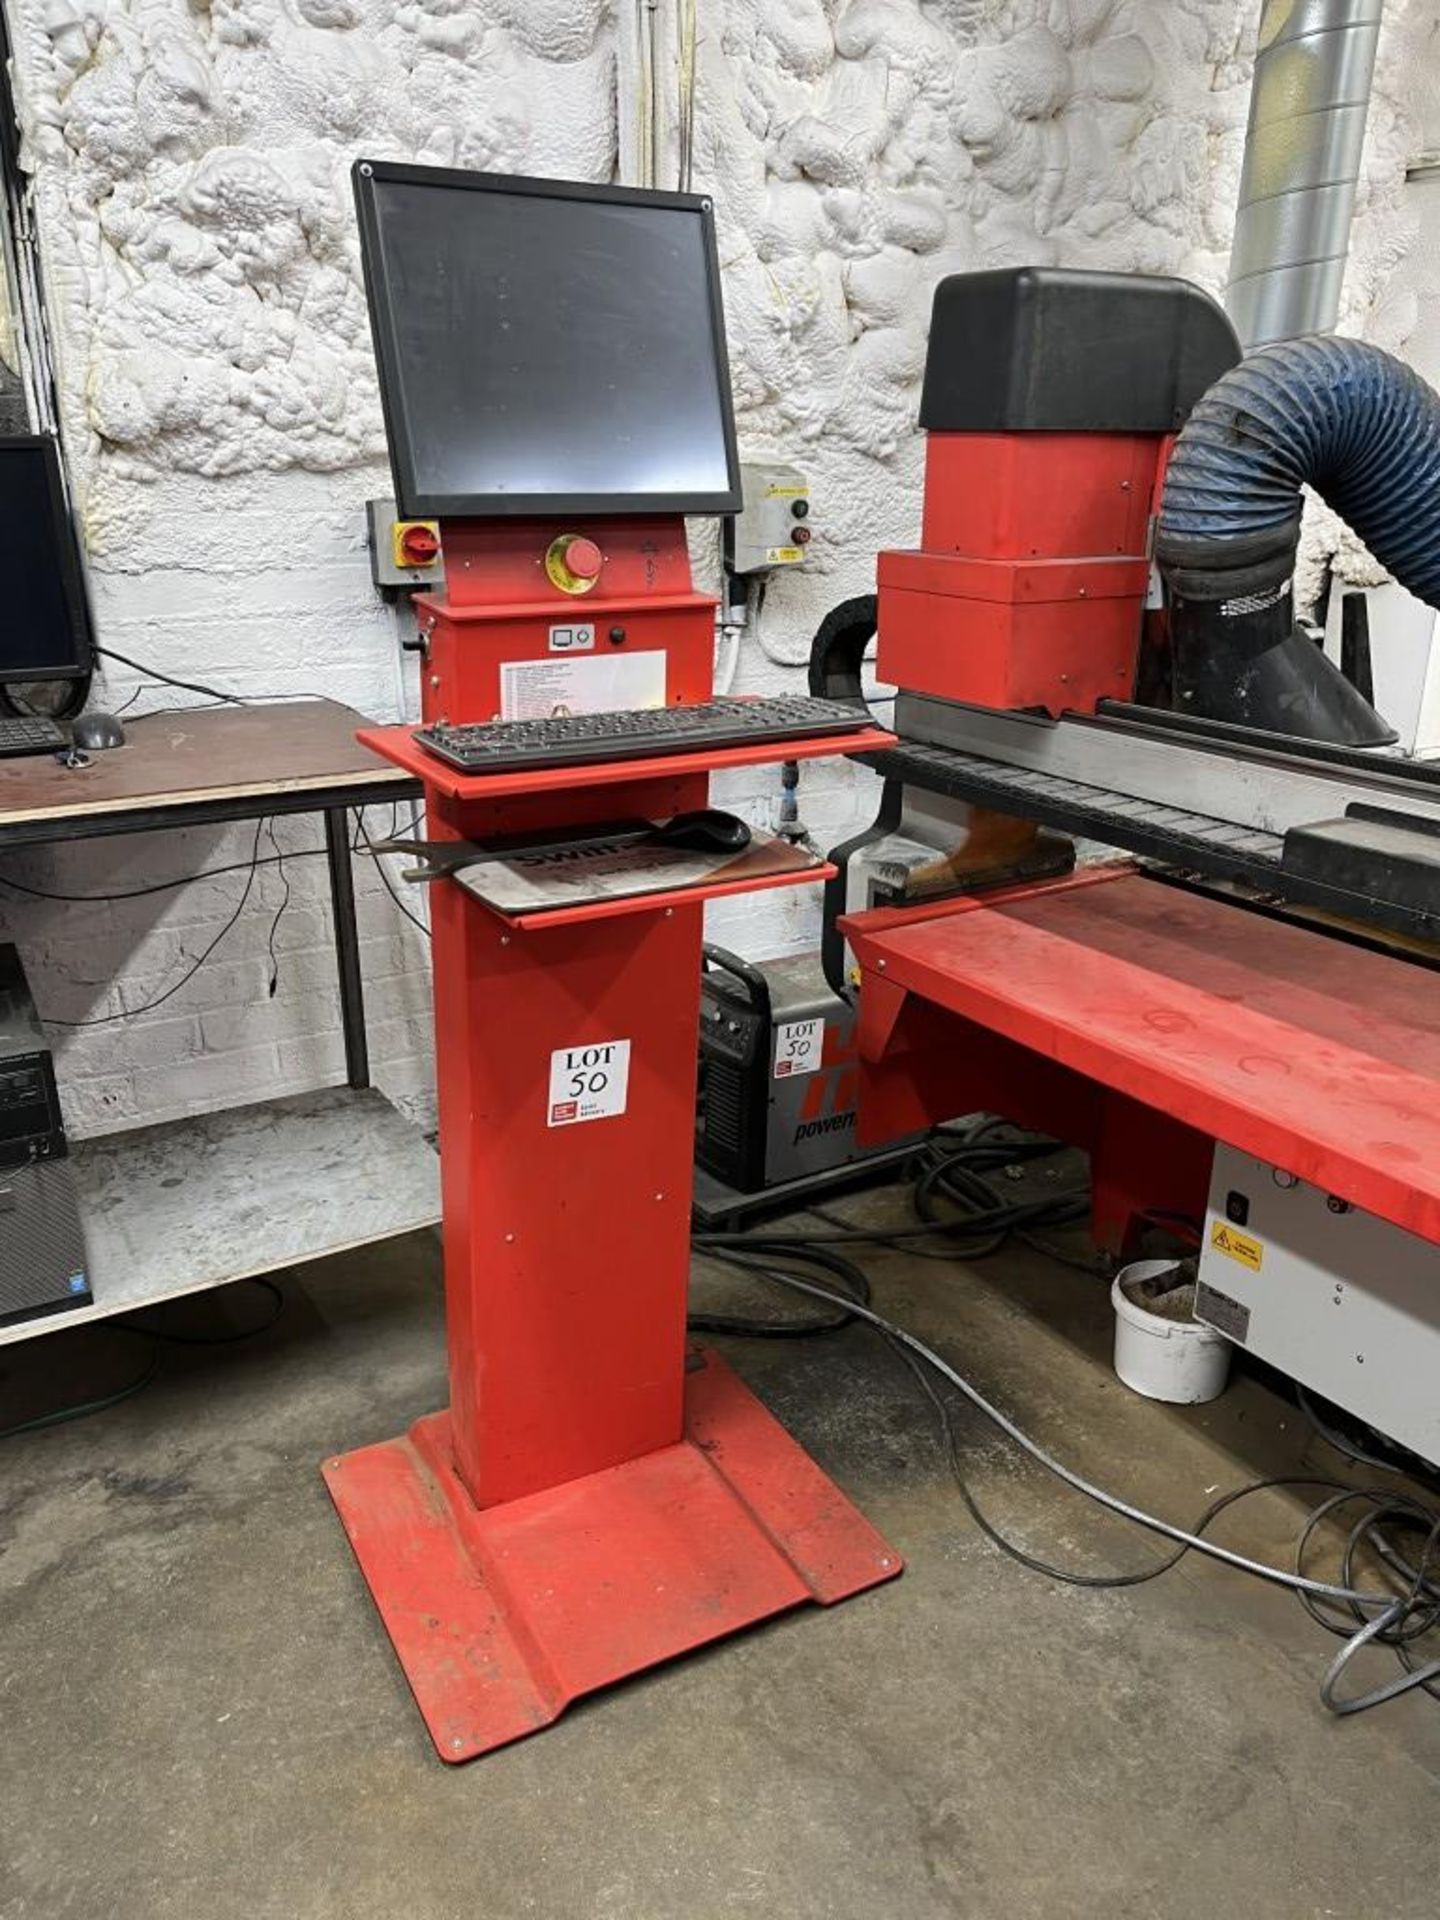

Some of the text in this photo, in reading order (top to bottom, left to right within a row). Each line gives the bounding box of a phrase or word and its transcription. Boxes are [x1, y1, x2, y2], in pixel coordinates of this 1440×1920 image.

[785, 1021, 817, 1040] LOT
[566, 1046, 616, 1070] LOT
[785, 1040, 811, 1057] 50
[569, 1071, 609, 1098] 50
